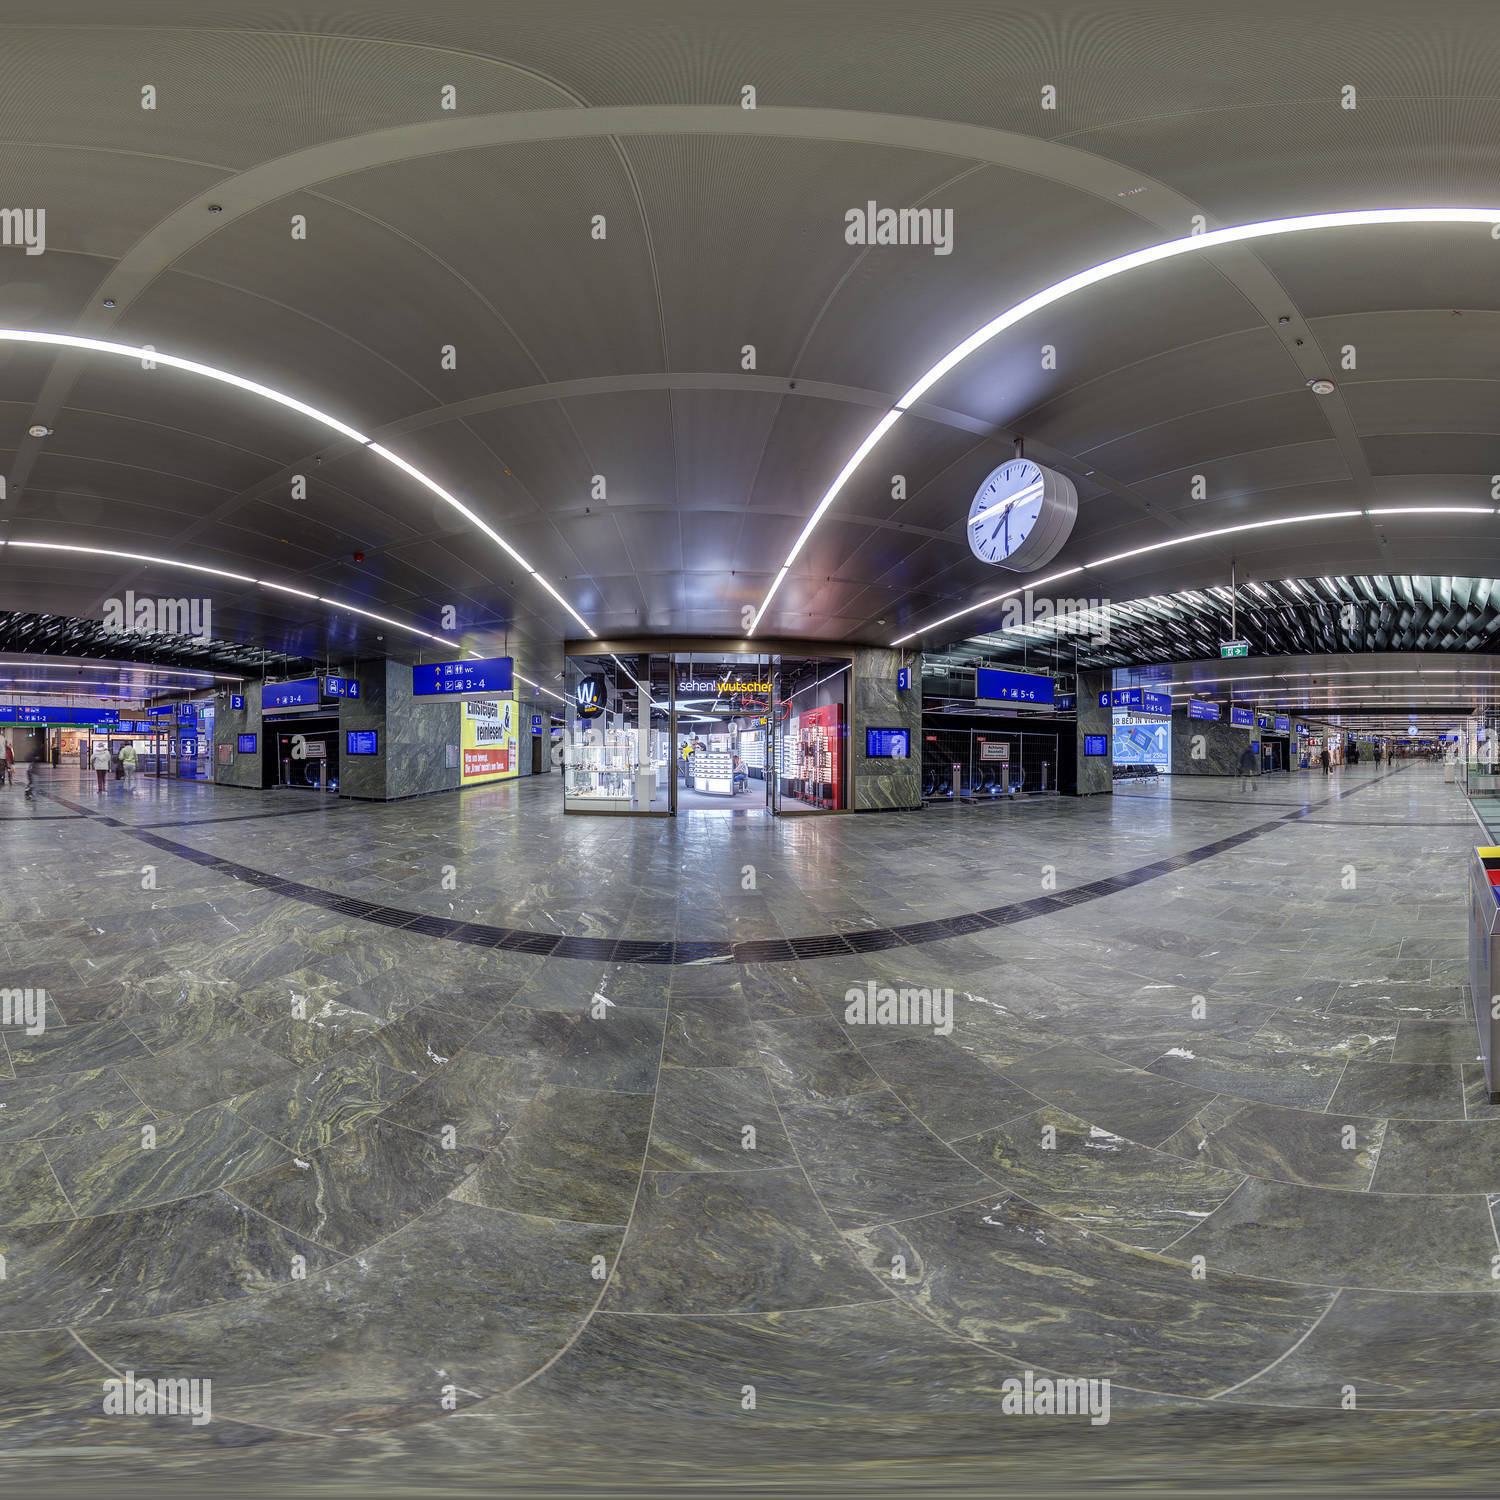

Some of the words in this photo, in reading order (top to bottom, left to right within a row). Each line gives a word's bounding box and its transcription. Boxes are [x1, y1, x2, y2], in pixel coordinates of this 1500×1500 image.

[899, 672, 905, 687] 5
[350, 683, 357, 696] 4
[680, 680, 716, 692] sehen!
[717, 682, 772, 692] wutscher
[290, 695, 302, 703] 3-4
[1020, 690, 1034, 699] 5-6
[1102, 694, 1108, 705] 6
[234, 697, 241, 708] 3
